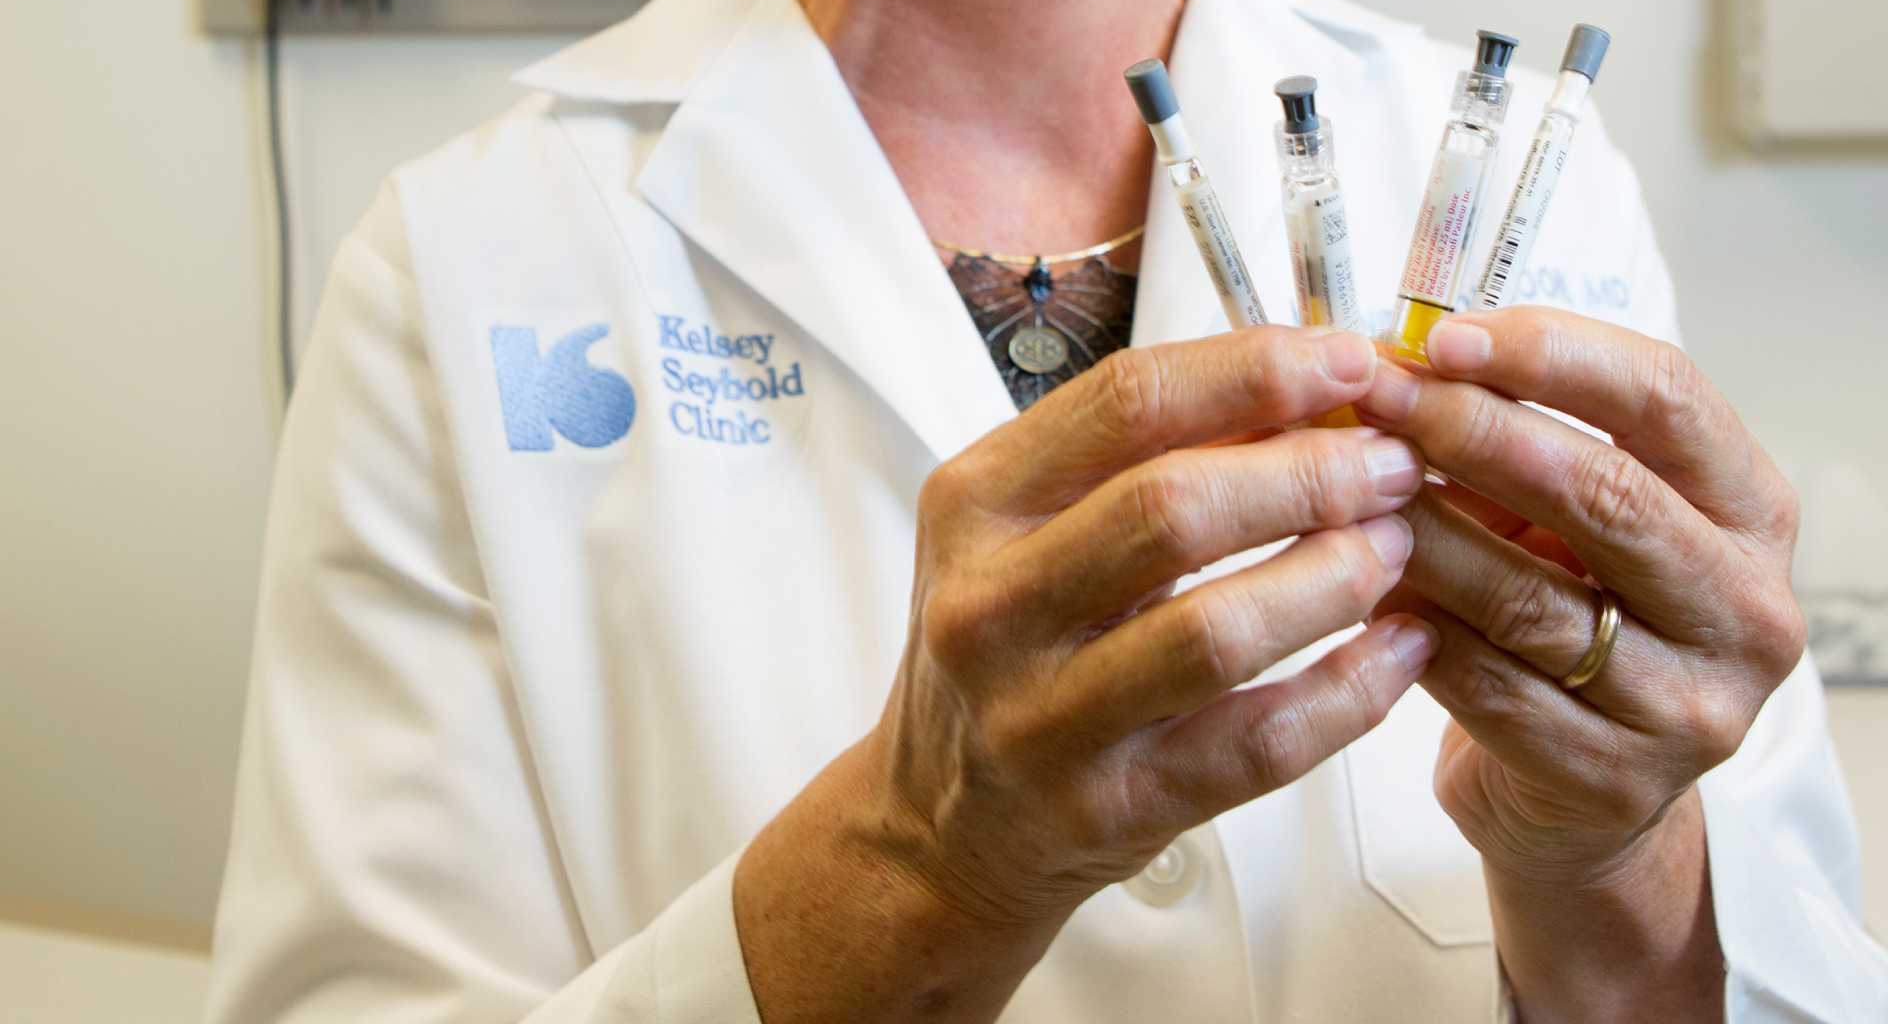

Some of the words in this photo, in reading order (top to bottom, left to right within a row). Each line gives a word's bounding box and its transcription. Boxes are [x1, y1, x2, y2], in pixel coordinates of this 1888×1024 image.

[1444, 238, 1457, 264] Sanofi
[1452, 204, 1466, 236] Pasteur
[1425, 256, 1441, 295] Pediatric
[657, 316, 774, 364] Kelsey
[661, 357, 805, 405] Seybold
[669, 400, 771, 445] Clinic
